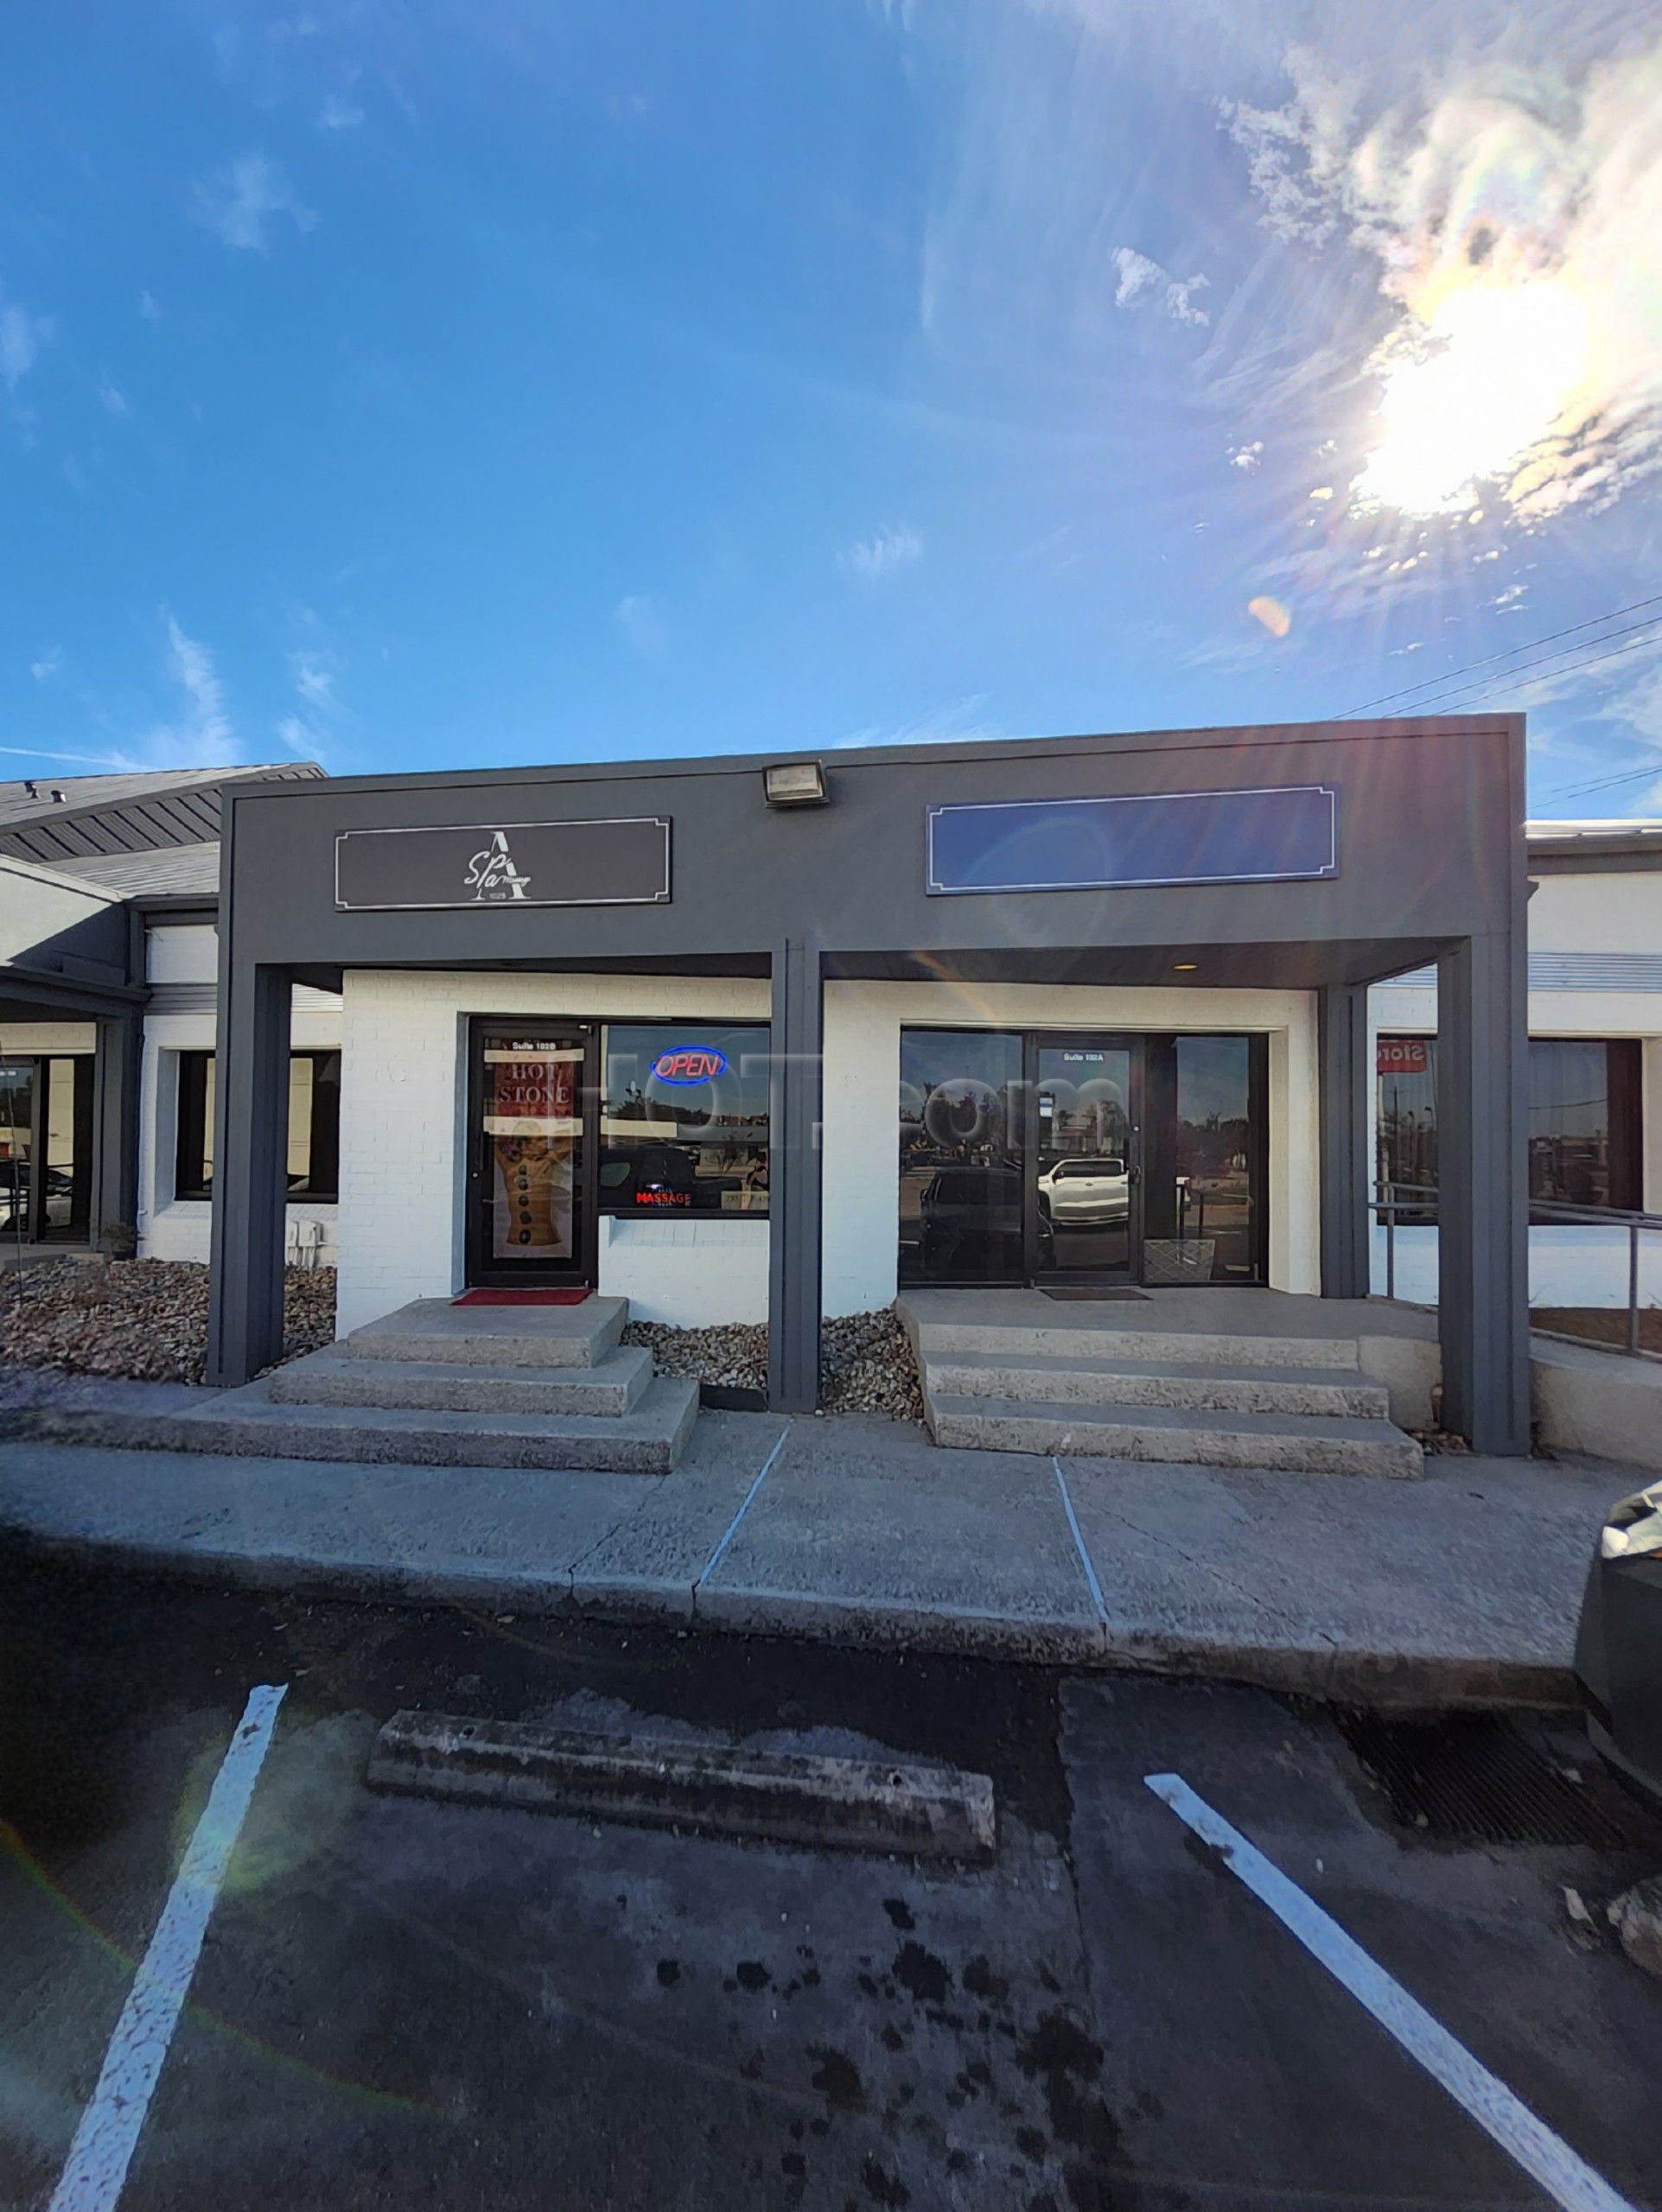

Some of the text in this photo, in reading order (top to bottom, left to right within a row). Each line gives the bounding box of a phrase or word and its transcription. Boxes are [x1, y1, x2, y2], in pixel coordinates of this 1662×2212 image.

[512, 1040, 533, 1050] Suite
[1063, 1052, 1084, 1061] Suite
[512, 1064, 559, 1080] HOT
[655, 1054, 720, 1077] OPEN
[500, 1086, 570, 1104] STONE
[636, 1192, 691, 1204] MASSAGE
